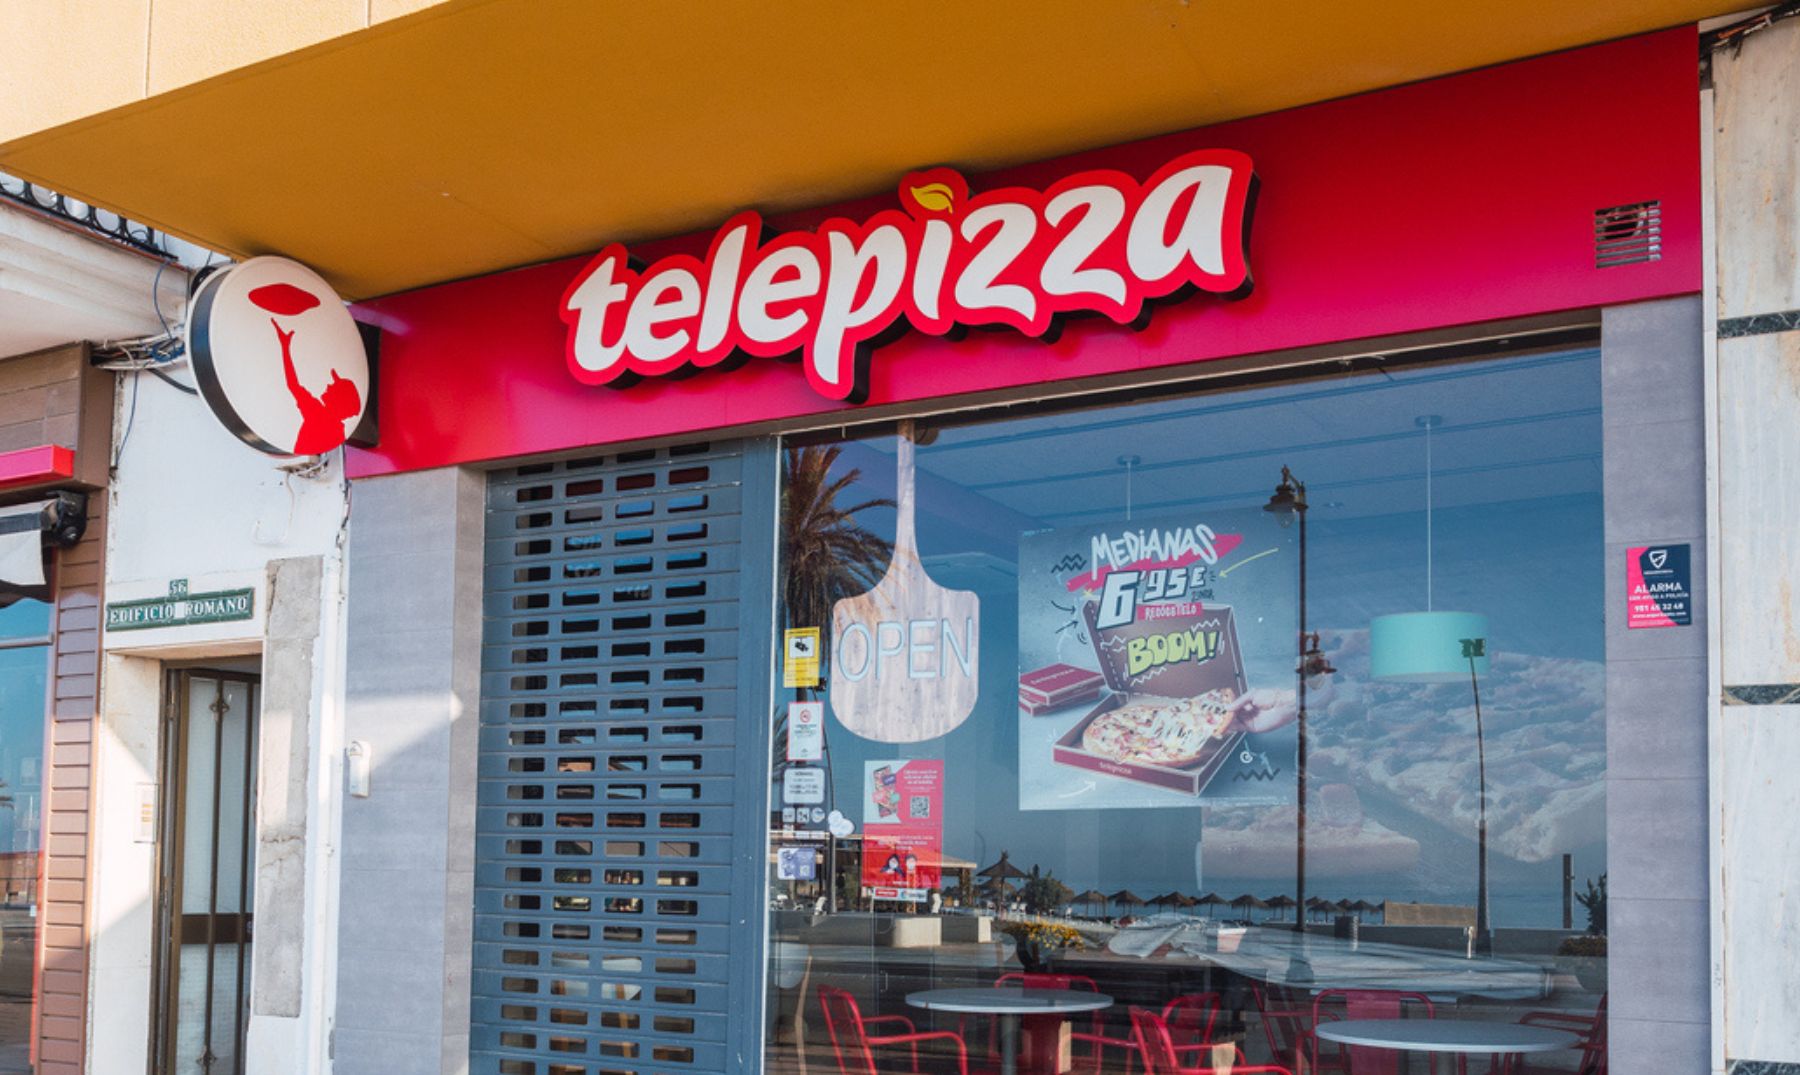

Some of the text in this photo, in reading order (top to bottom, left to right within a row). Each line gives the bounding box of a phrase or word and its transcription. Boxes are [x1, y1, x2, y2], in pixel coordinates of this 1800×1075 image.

[566, 163, 1233, 385] telepizza
[1091, 523, 1218, 581] MEDIANAS
[110, 597, 247, 624] EDIFICIO ROMANO
[1634, 582, 1682, 594] ALARMA
[838, 617, 973, 683] OPEN
[1127, 630, 1220, 677] BOOM!
